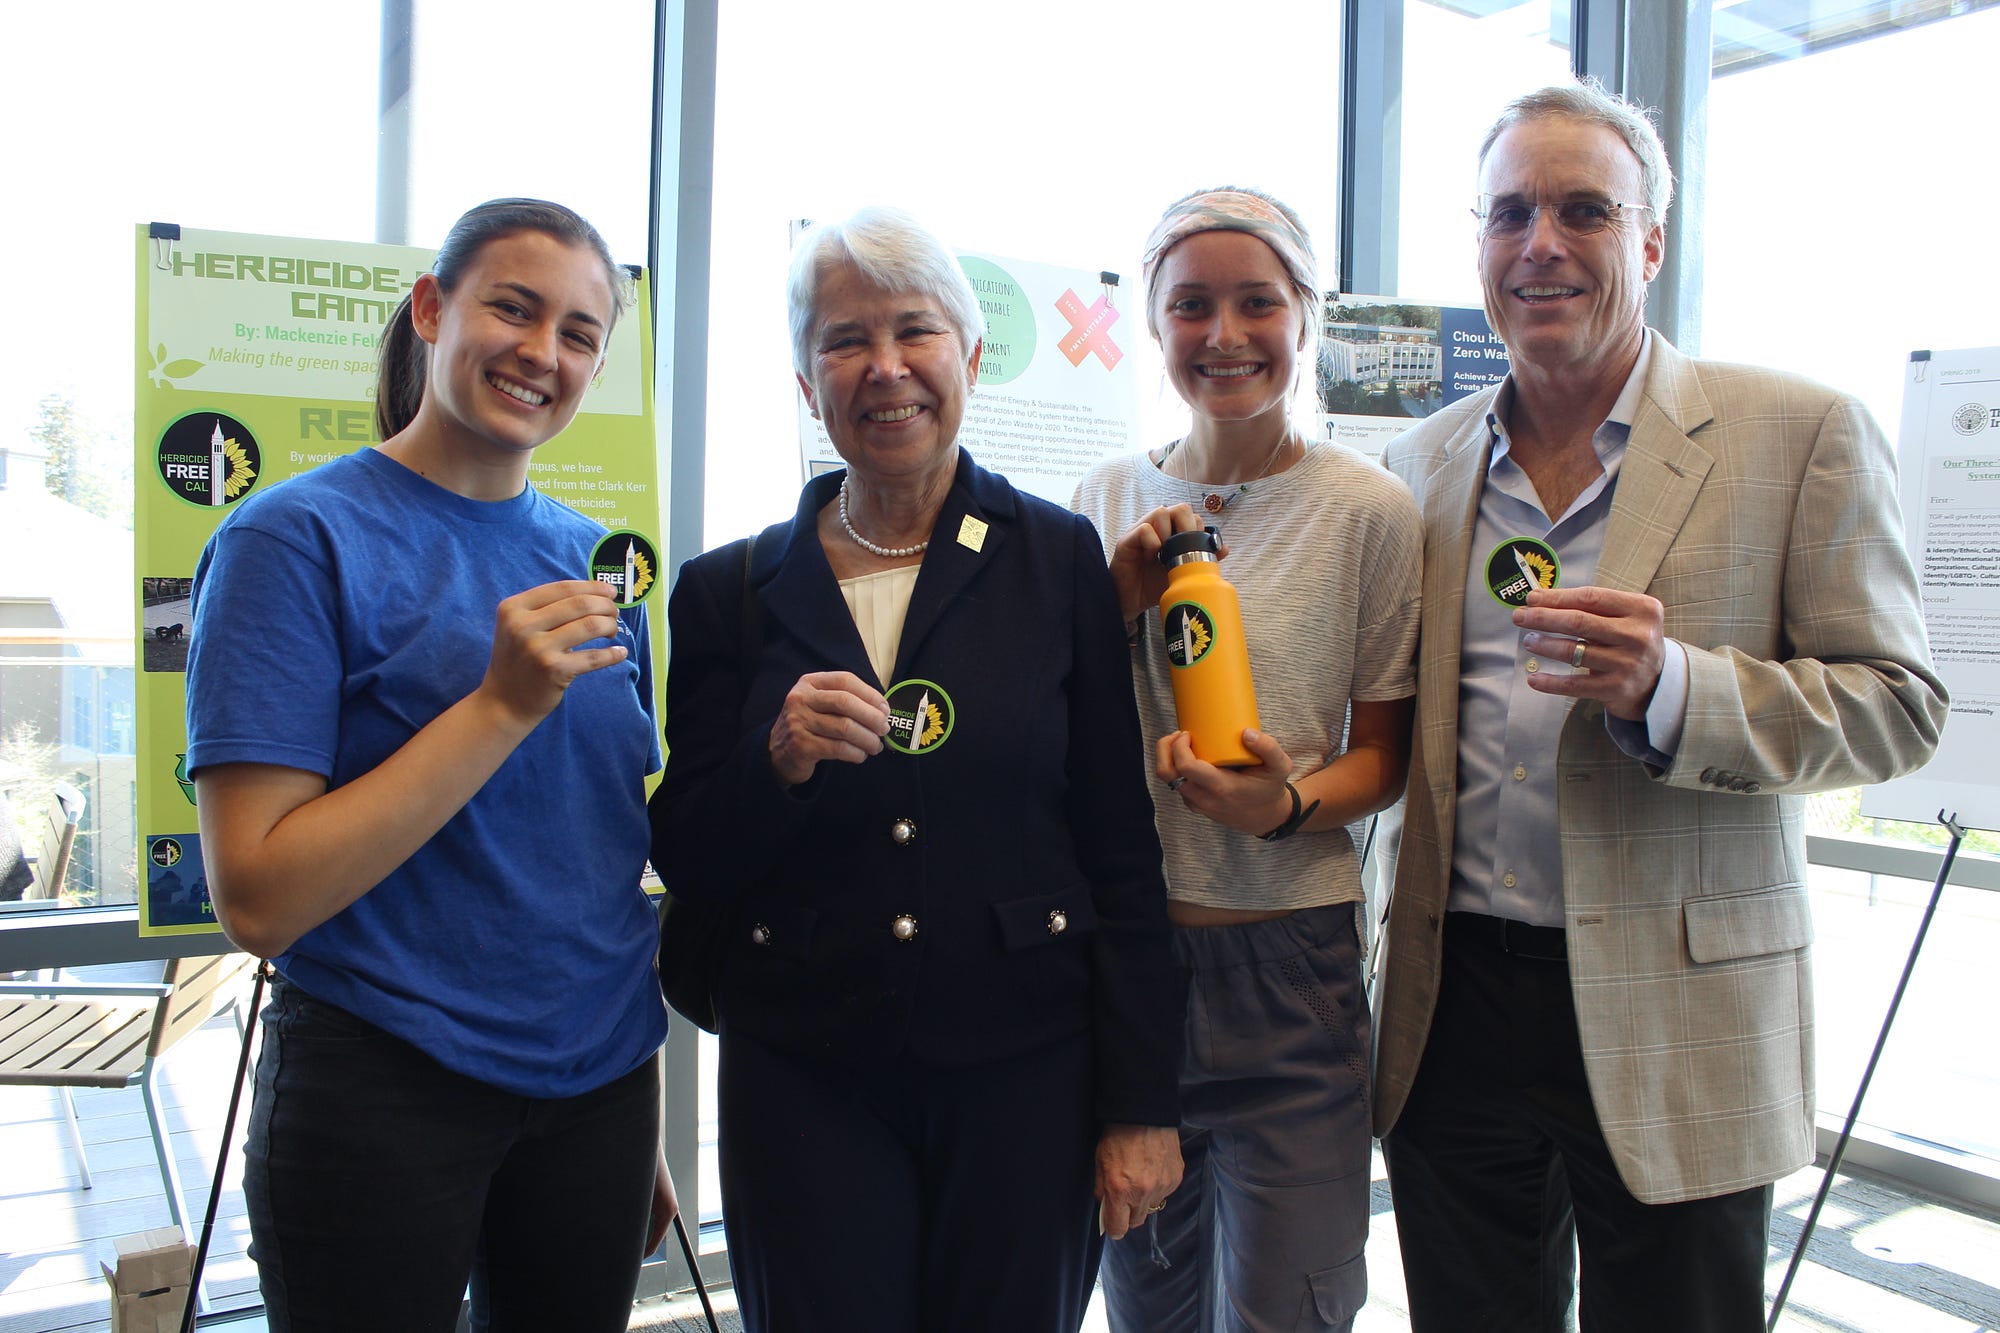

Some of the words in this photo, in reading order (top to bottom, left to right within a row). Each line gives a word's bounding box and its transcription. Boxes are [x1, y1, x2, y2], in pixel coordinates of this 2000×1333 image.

[235, 323, 260, 339] By:
[265, 325, 347, 346] Mackenzie
[1453, 330, 1485, 343] Chou
[1453, 346, 1481, 359] Zero
[208, 347, 264, 368] Making
[269, 350, 292, 367] the
[298, 355, 339, 373] green
[1454, 371, 1487, 381] Achieve
[1453, 382, 1481, 391] Create
[1008, 396, 1031, 406] Energy
[1031, 399, 1037, 407] &
[1082, 405, 1093, 413] the
[994, 407, 1014, 416] across
[1015, 409, 1026, 417] the
[1040, 413, 1062, 421] system
[1076, 416, 1092, 425] bring
[974, 416, 988, 424] goal
[997, 418, 1012, 426] Zero
[1013, 420, 1034, 429] Waste
[1034, 423, 1043, 431] by
[1063, 425, 1073, 433] To
[1073, 426, 1085, 434] this
[1338, 424, 1355, 432] Spring
[976, 427, 983, 435] to
[983, 429, 1008, 438] explore
[1009, 432, 1044, 442] messaging
[1086, 438, 1096, 446] for
[983, 439, 996, 447] The
[997, 441, 1020, 449] current
[1022, 444, 1044, 453] project
[1044, 446, 1073, 455] operates
[1073, 449, 1092, 457] under
[1093, 450, 1104, 458] the
[160, 453, 209, 464] HERBICIDE
[290, 450, 304, 464] By
[561, 464, 576, 472] we
[578, 462, 603, 473] have
[994, 452, 1016, 460] Center
[1017, 454, 1043, 464] (SERC)
[1051, 458, 1092, 468] collaboration
[1943, 459, 1962, 469] Our
[166, 464, 209, 480] FREE
[990, 463, 1034, 474] Development
[1035, 467, 1064, 477] Practice,
[1064, 469, 1077, 477] and
[185, 481, 208, 492] CAL
[553, 478, 577, 490] from
[580, 479, 596, 490] the
[598, 480, 623, 491] Clark
[626, 482, 647, 492] Kerr
[564, 496, 616, 508] herbicides
[1930, 496, 1949, 504] First
[609, 516, 627, 526] and
[593, 565, 624, 573] HERBICIDE
[1924, 564, 1970, 572] Organizations,
[597, 573, 624, 585] FREE
[1499, 577, 1529, 600] FREE
[1168, 639, 1184, 654] FREE
[1951, 706, 1994, 716] sustainability
[888, 715, 914, 731] FREE
[894, 729, 911, 739] CAL
